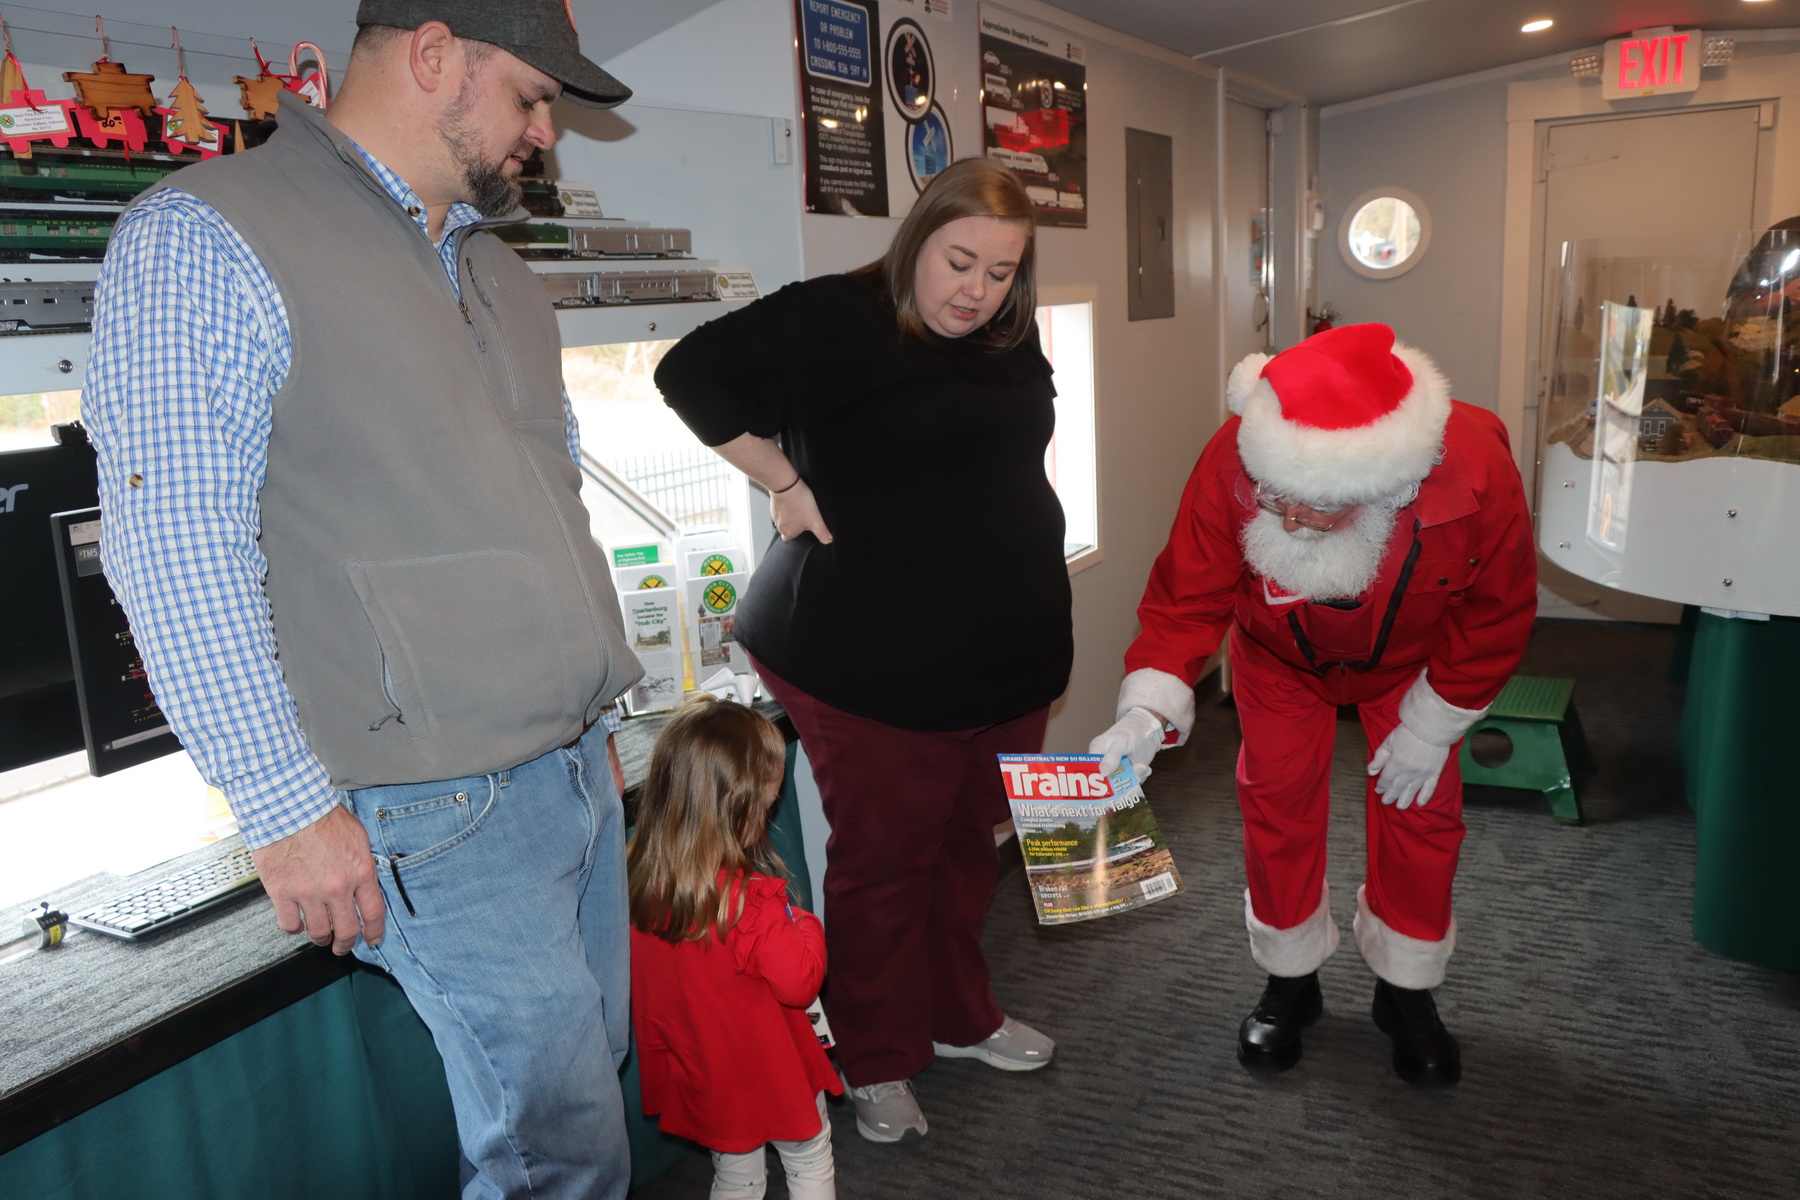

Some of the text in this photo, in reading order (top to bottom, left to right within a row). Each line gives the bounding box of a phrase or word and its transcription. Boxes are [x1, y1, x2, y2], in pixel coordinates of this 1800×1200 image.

[809, 0, 861, 23] REPORT EMERGENCY
[820, 21, 853, 39] OR PROBLEM
[814, 37, 821, 50] TO
[810, 55, 837, 72] CROSSING
[1619, 34, 1690, 89] EXIT
[632, 606, 667, 614] Spartanburg
[1000, 764, 1109, 797] Trains
[1017, 794, 1141, 819] What's next for Talgo
[1026, 838, 1079, 848] Peak performance
[1038, 884, 1059, 893] Broken
